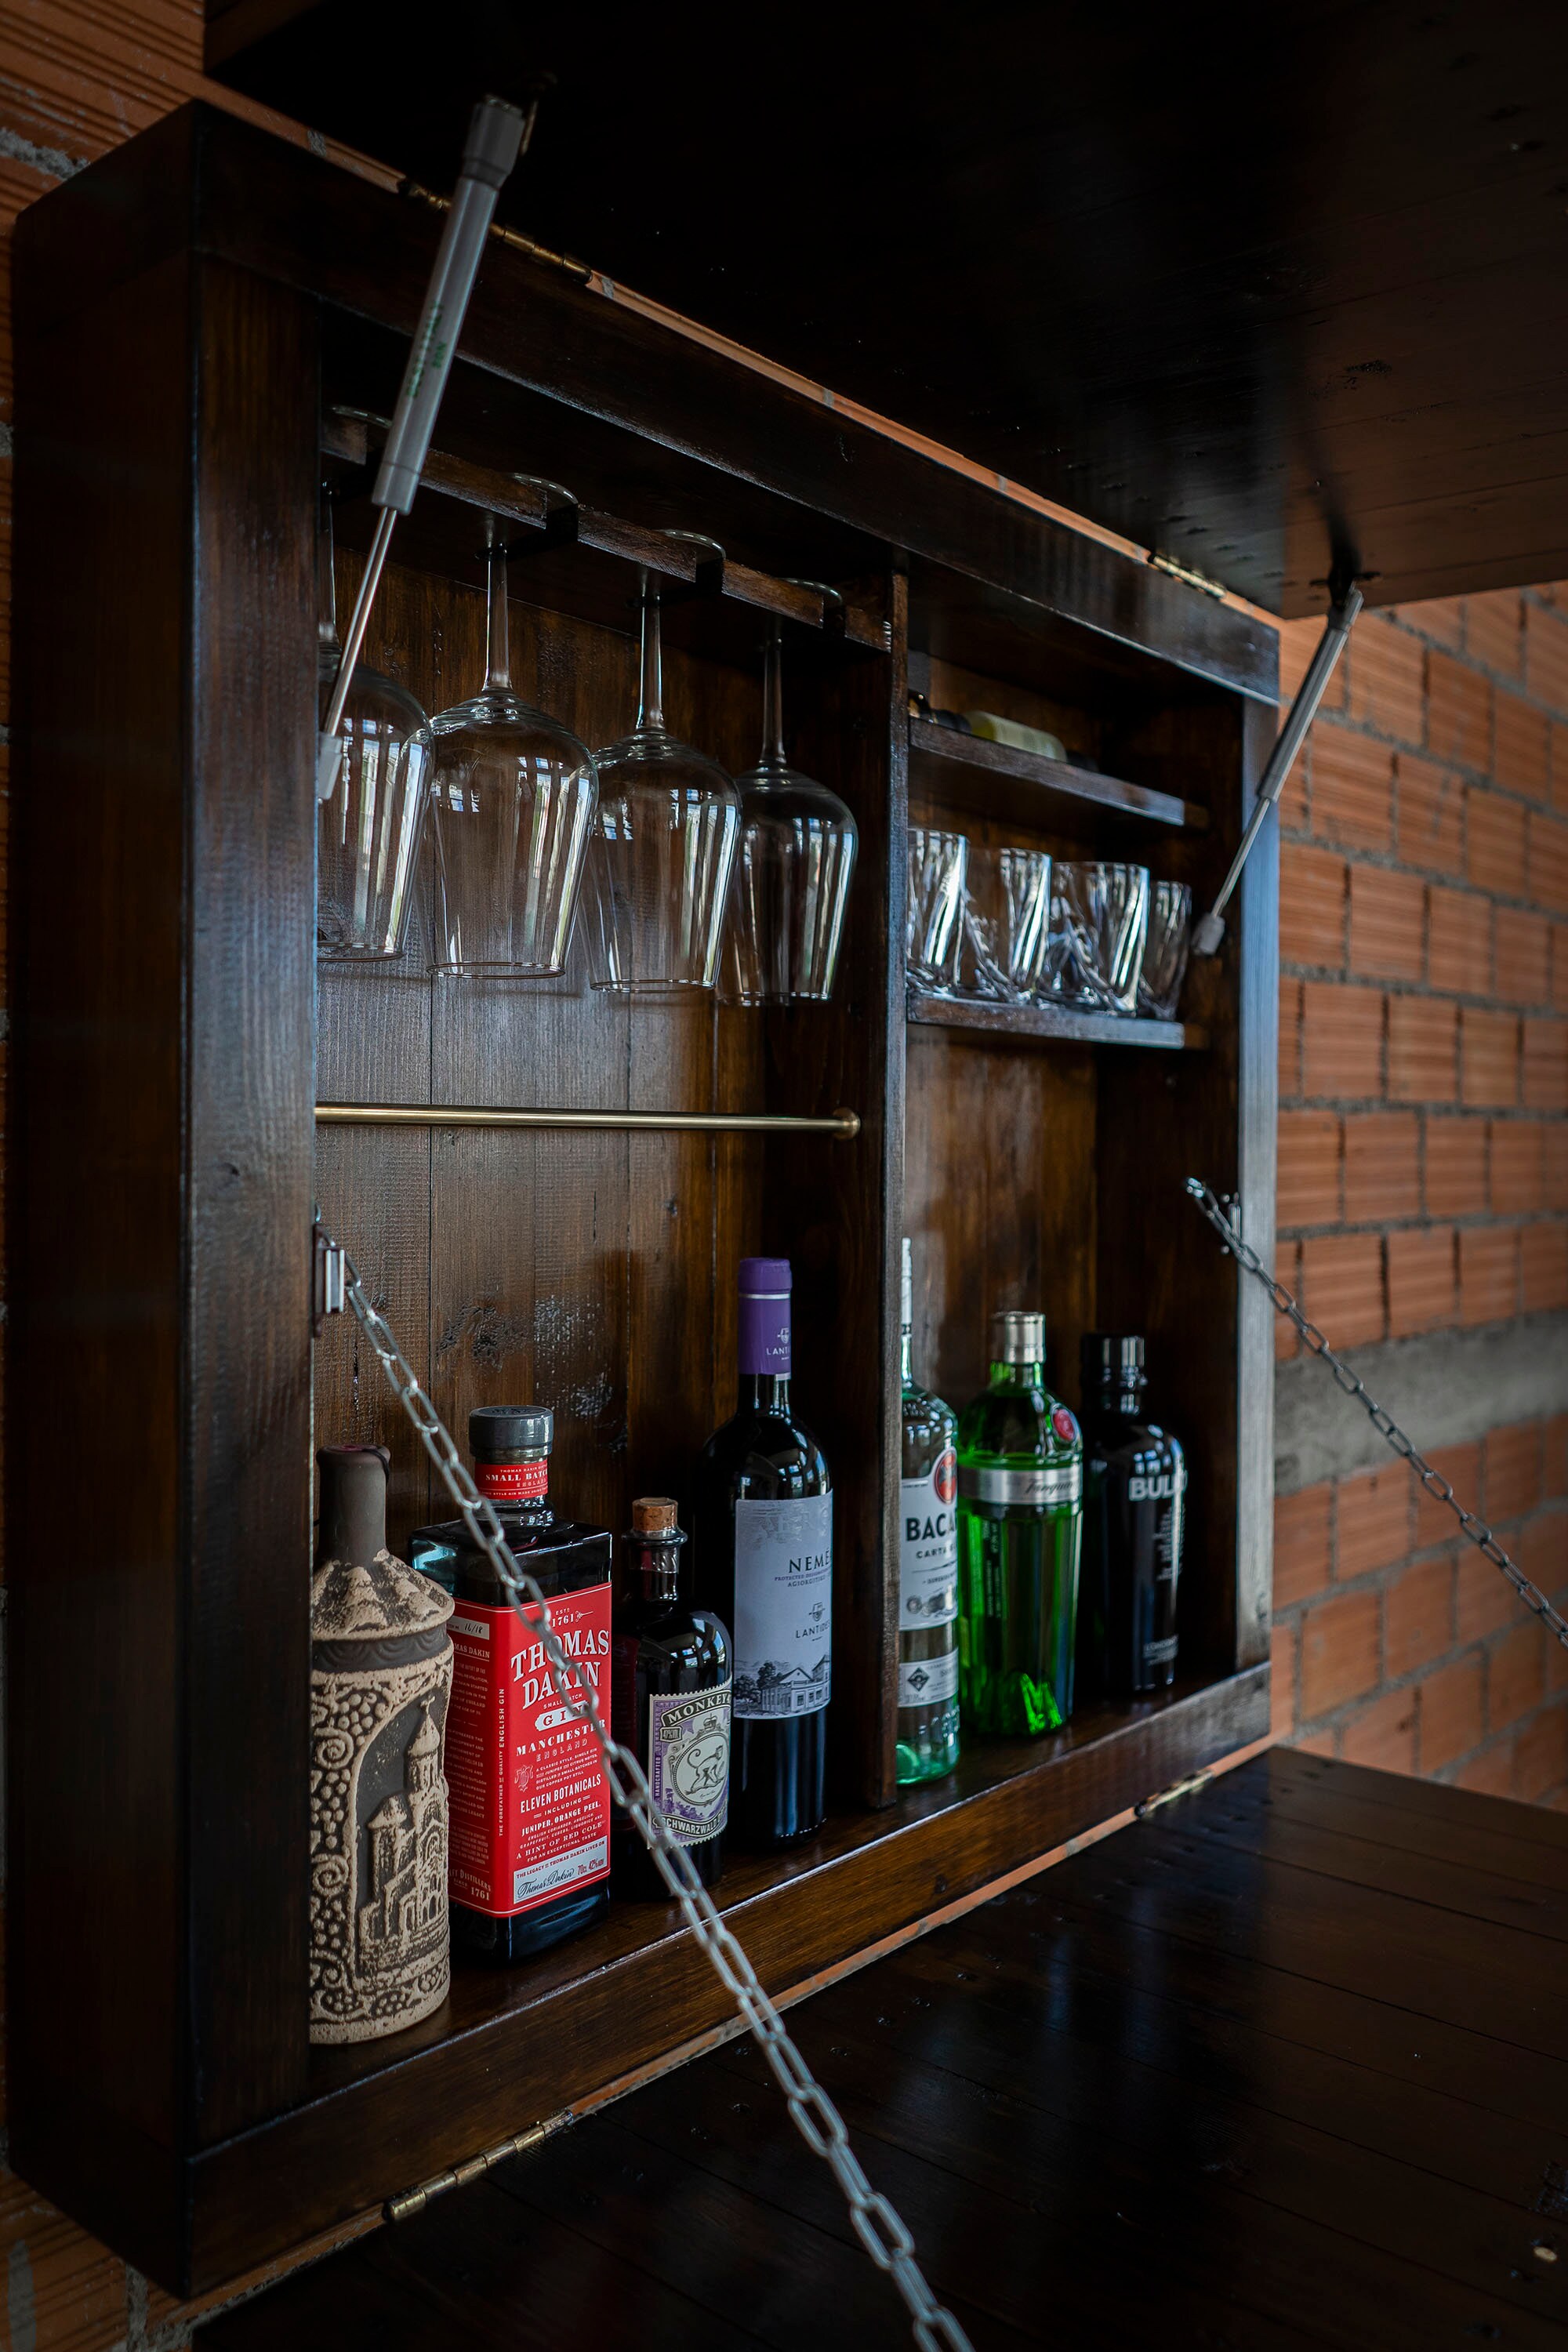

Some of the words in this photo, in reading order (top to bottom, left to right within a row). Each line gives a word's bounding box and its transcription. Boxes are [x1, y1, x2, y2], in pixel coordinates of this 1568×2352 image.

[551, 1613, 574, 1628] 1761
[469, 1646, 490, 1659] DAKIN
[510, 1629, 609, 1682] THOMAS
[522, 1661, 601, 1709] DAKIN
[543, 1700, 563, 1709] SMALL
[666, 1693, 728, 1724] MONKEY
[516, 1719, 605, 1756] MANCHESTER
[535, 1738, 587, 1762] ENGLAND
[540, 1762, 558, 1770] CLASSIC
[574, 1750, 590, 1759] SINGLE
[535, 1773, 557, 1784] DISTILLED
[575, 1762, 593, 1770] BATCHES
[545, 1766, 563, 1776] JUNIPER
[546, 1777, 563, 1788] COPPER
[520, 1791, 552, 1813] ELEVEN
[554, 1773, 601, 1802] BOTANICALS
[468, 1808, 485, 1819] LEGACY
[544, 1797, 582, 1816] INCLUDING
[554, 1807, 581, 1824] ORANGE
[571, 1818, 593, 1830] LIQUORICE
[525, 1843, 546, 1857] HINT
[549, 1838, 561, 1847] OF
[563, 1831, 579, 1842] RED
[582, 1821, 603, 1834] COLE
[528, 1831, 546, 1841] ENGLISH
[546, 1839, 580, 1855] EXCEPTIONAL
[582, 1832, 597, 1841] TASTE
[526, 1865, 544, 1876] LEGACY
[549, 1855, 569, 1866] THOMAS
[569, 1849, 584, 1859] DAKIN
[585, 1843, 598, 1852] LIVES
[517, 1878, 546, 1898] Thomas
[546, 1867, 575, 1887] Dakin
[470, 1886, 490, 1901] 1761
